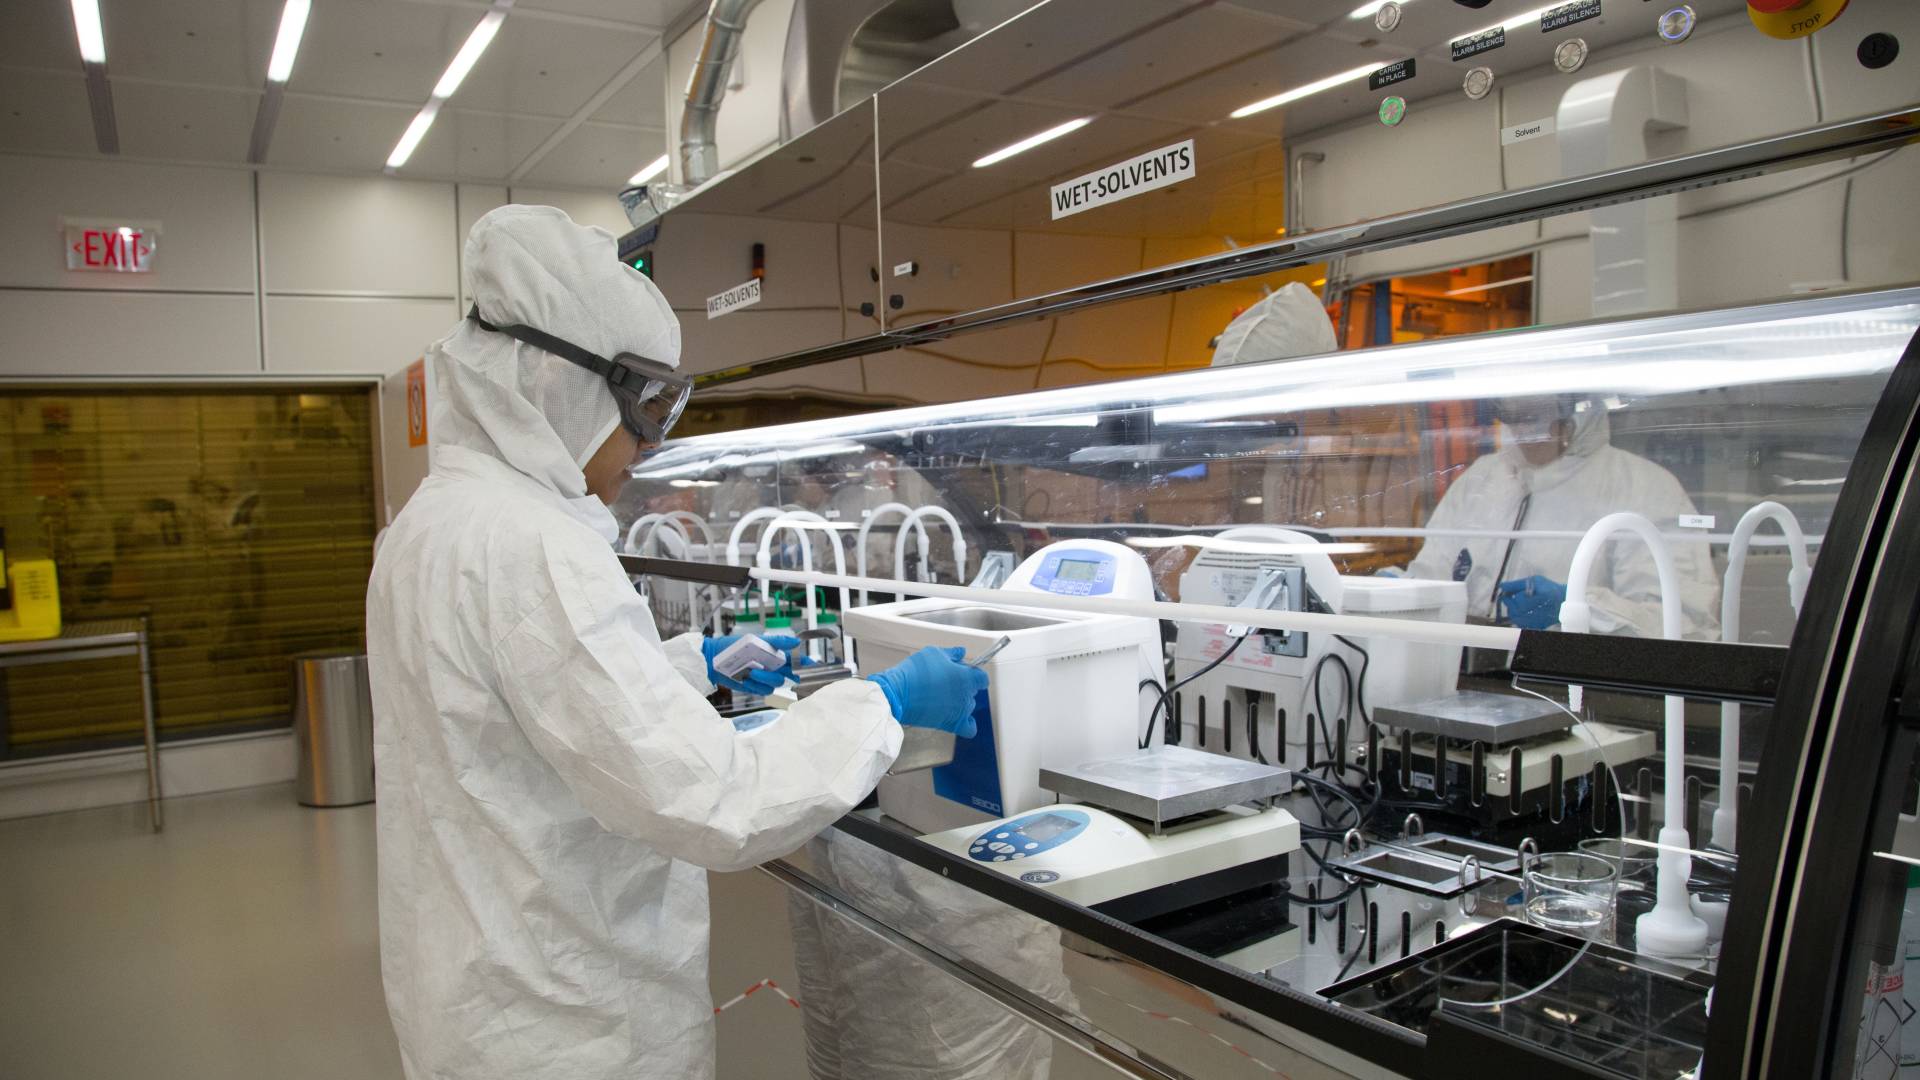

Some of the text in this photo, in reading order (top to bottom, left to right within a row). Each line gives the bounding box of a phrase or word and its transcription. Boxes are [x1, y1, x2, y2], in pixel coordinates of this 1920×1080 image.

[1542, 5, 1600, 30] ALARM SILENCE
[1790, 13, 1822, 34] STOP
[1453, 43, 1475, 57] ALARM
[1476, 35, 1504, 50] SILENCE
[1379, 70, 1406, 85] IN PLACE
[1380, 62, 1405, 76] CARBOY
[1515, 125, 1540, 138] Solvent
[1055, 146, 1191, 212] WET-SOLVENTS
[84, 230, 142, 268] EXIT
[708, 281, 759, 313] WET-SOLVENTS
